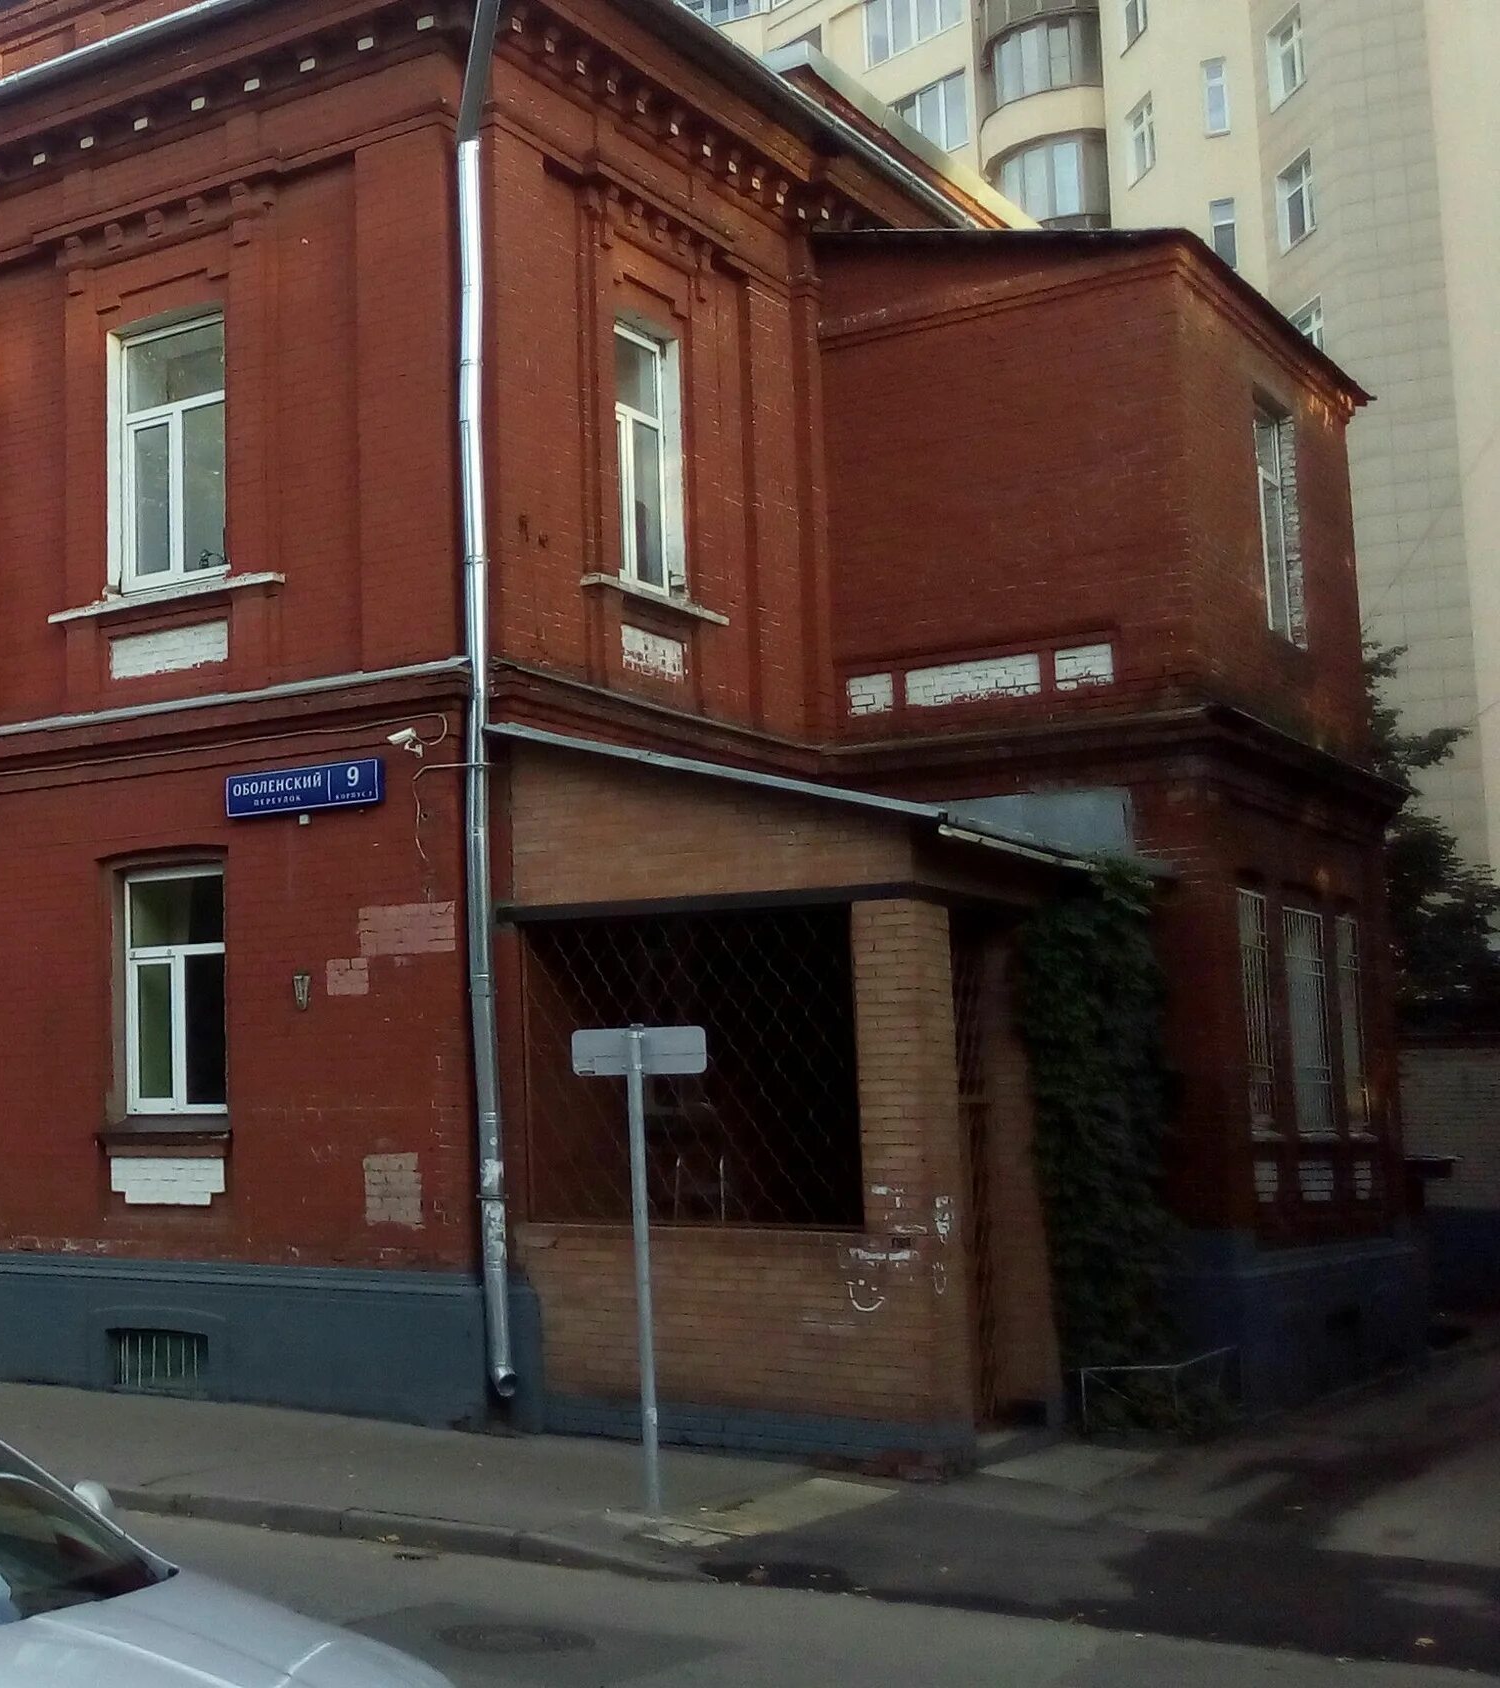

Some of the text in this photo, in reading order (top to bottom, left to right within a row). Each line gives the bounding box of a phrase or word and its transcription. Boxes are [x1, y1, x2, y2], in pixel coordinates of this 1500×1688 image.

[232, 772, 322, 797] ОБОЛЕНСКИЙ
[347, 766, 359, 787] 9
[253, 795, 301, 807] ПЕРЕУЛОК
